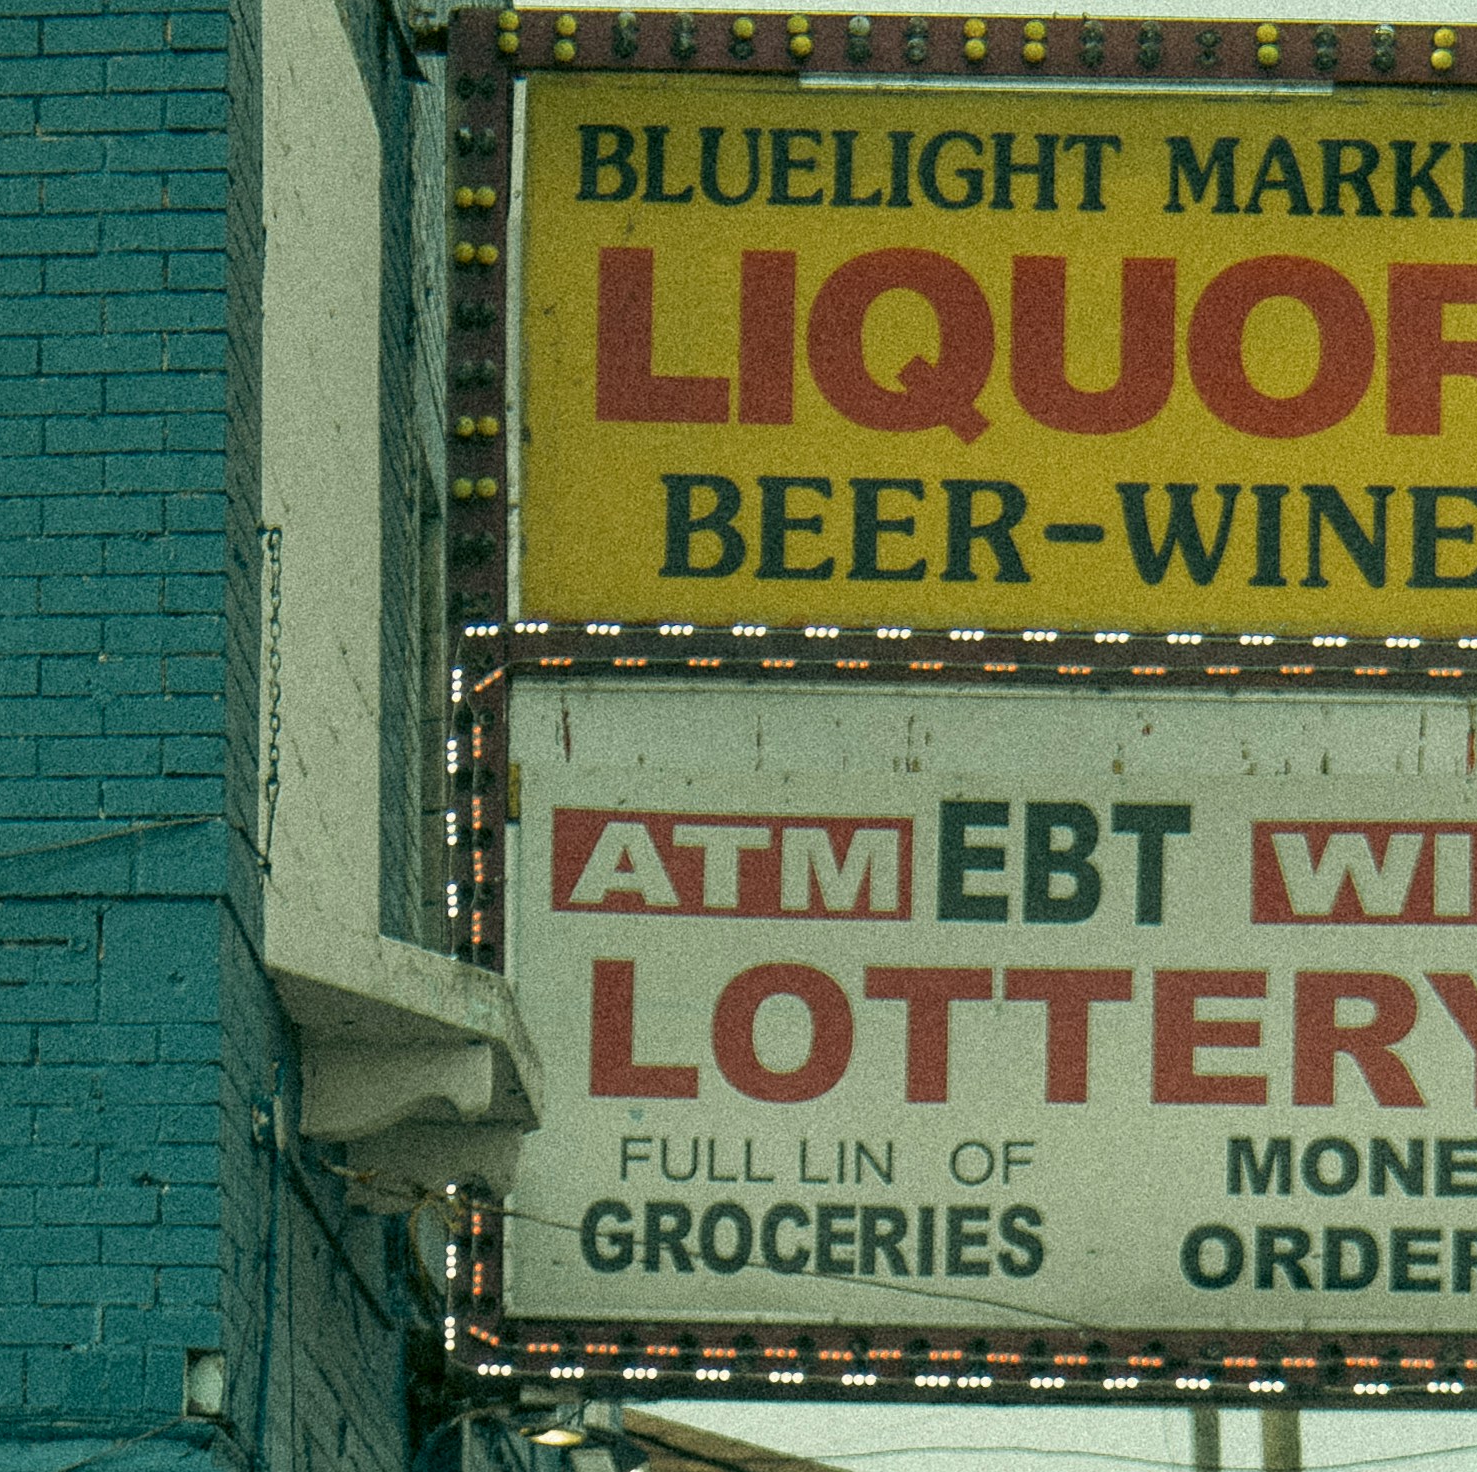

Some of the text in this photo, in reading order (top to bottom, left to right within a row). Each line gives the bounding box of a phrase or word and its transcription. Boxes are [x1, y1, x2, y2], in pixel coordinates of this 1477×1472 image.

[576, 122, 1123, 212] BLUELIGHT
[568, 820, 901, 914] ATM
[936, 799, 1193, 926] EBT
[619, 1135, 775, 1185] FULL
[948, 1139, 1036, 1188] OF
[578, 1198, 1046, 1279] GROCERIES
